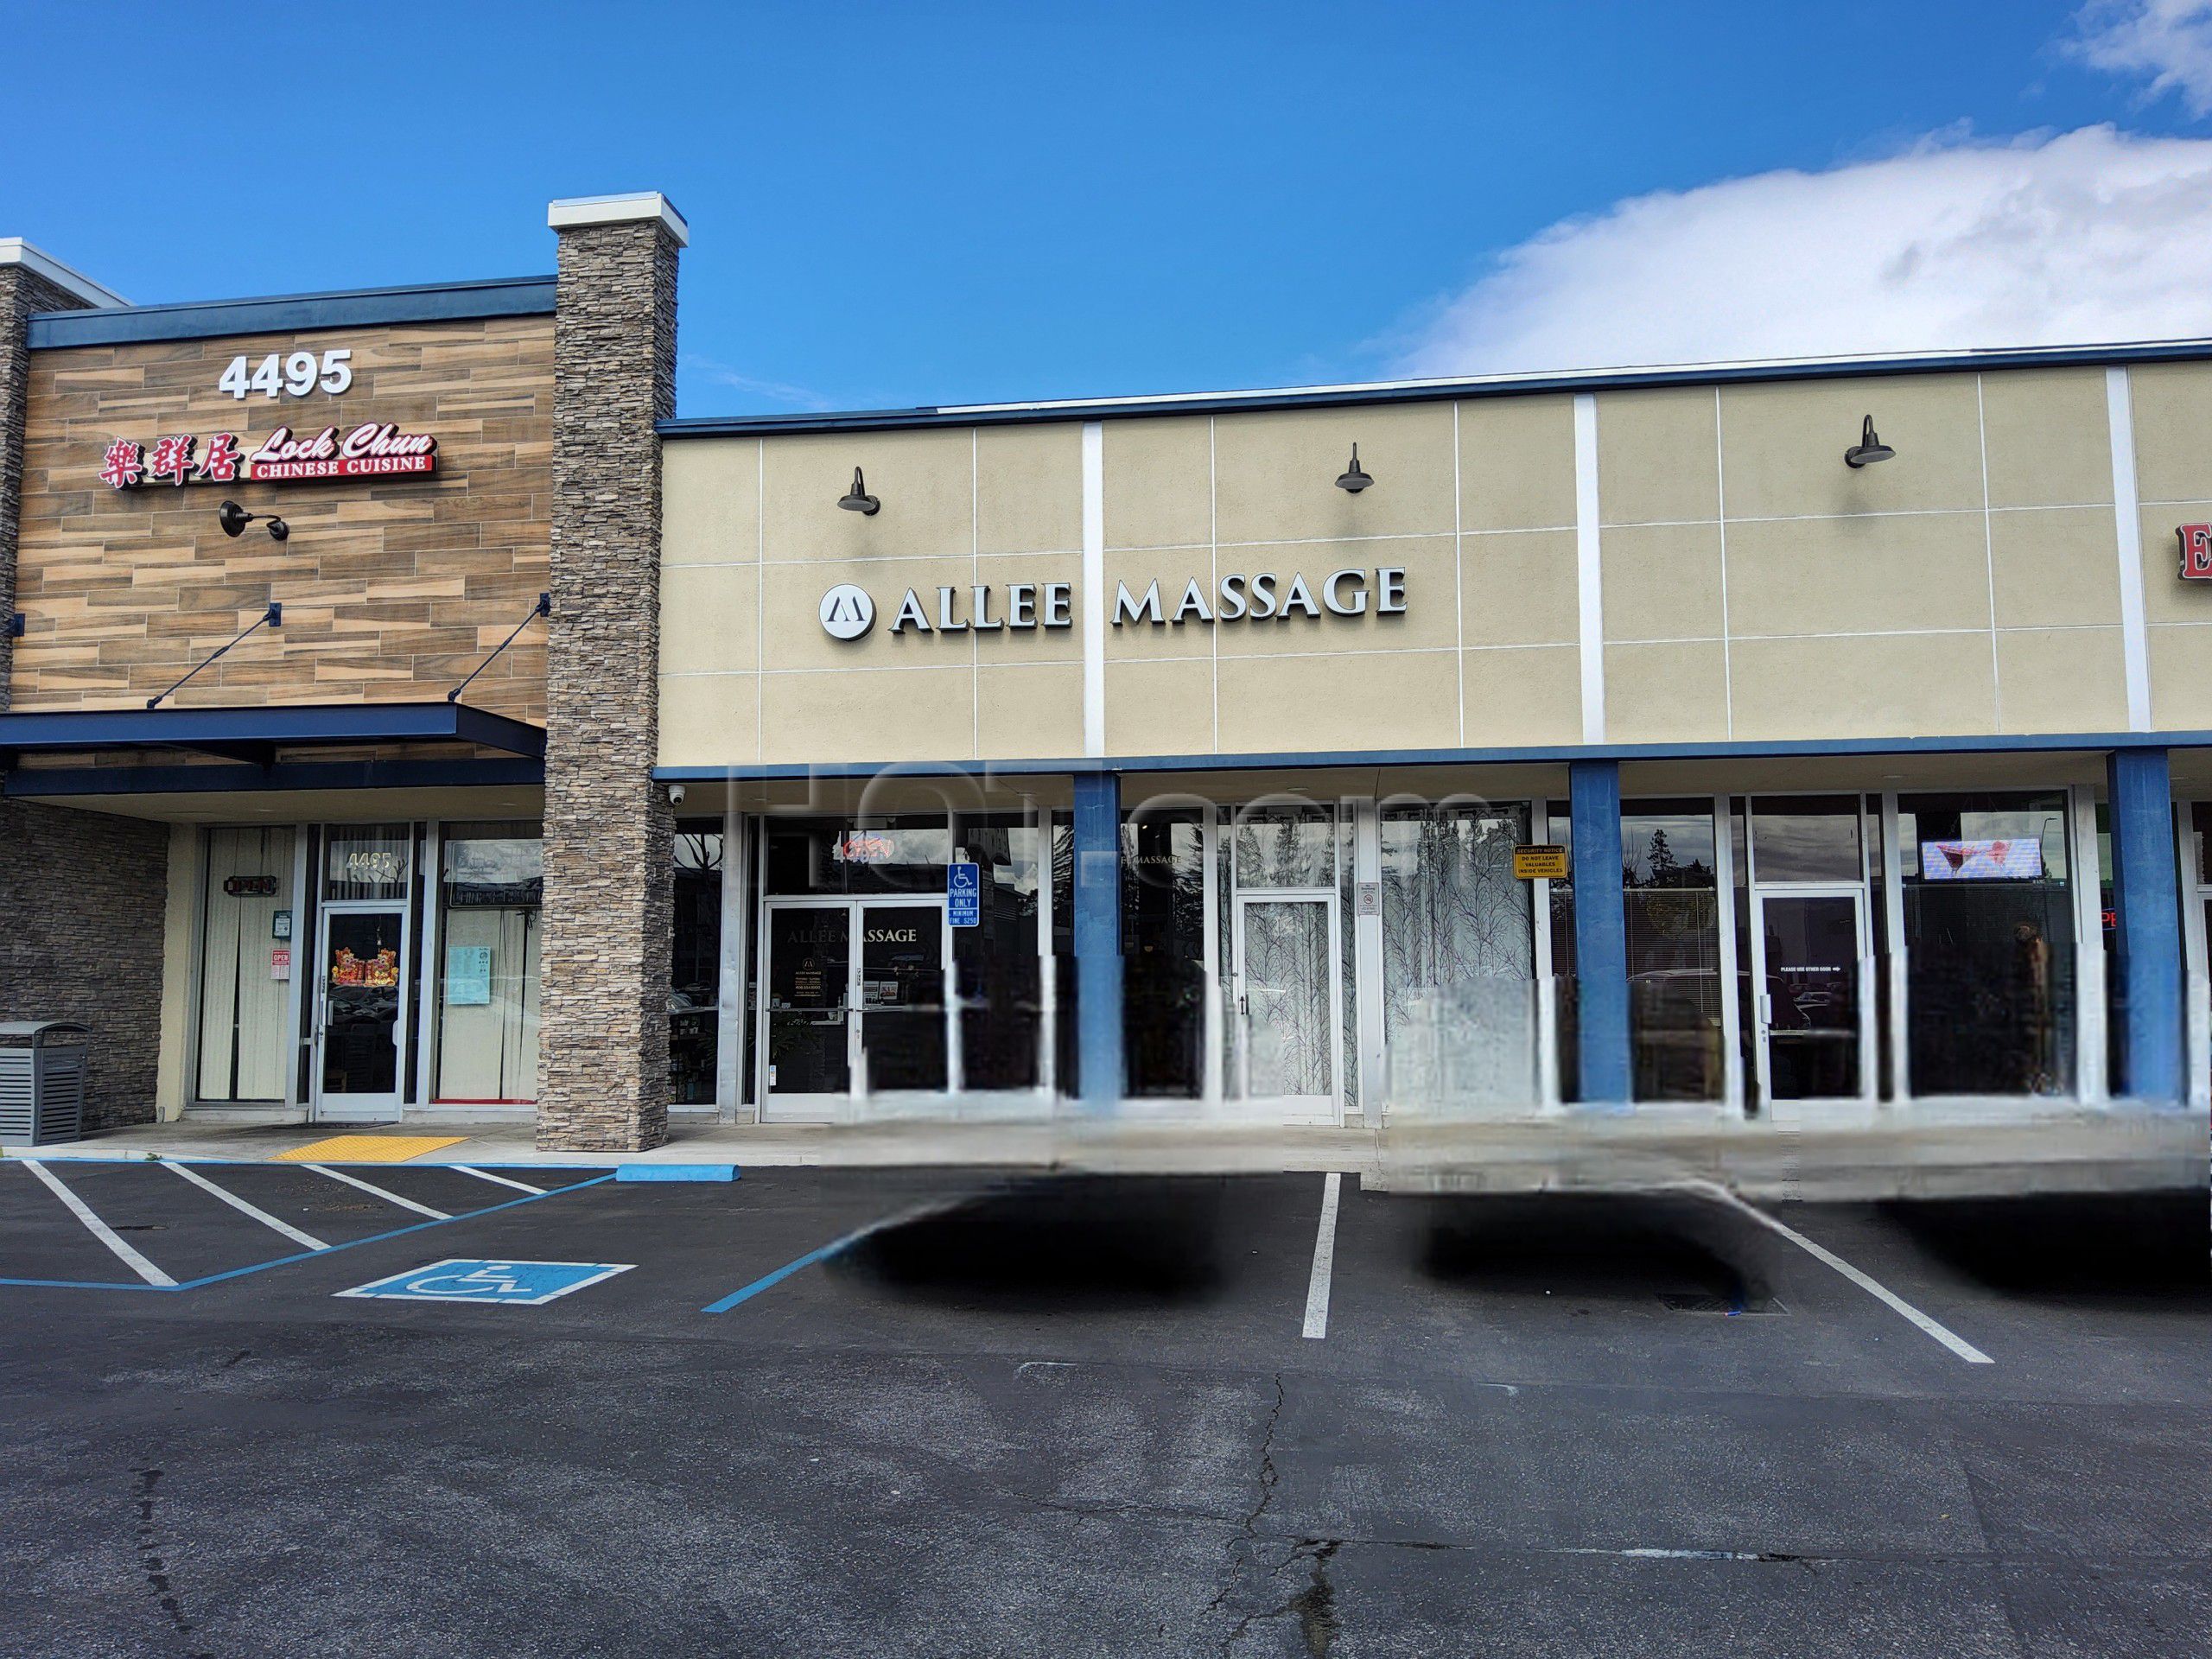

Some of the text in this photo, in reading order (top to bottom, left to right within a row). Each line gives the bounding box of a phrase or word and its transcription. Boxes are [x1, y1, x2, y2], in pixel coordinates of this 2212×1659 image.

[219, 348, 353, 399] 4495
[250, 420, 436, 463] Lock Chun
[98, 432, 245, 490] 樂群居
[256, 456, 427, 479] CHINESE CUISINE
[888, 582, 1074, 633] ALLEE
[1110, 566, 1408, 627] MASSAGE
[347, 852, 392, 870] 4495
[950, 888, 977, 898] PARKING
[955, 898, 972, 907] ONLY
[787, 930, 836, 943] ALLEE
